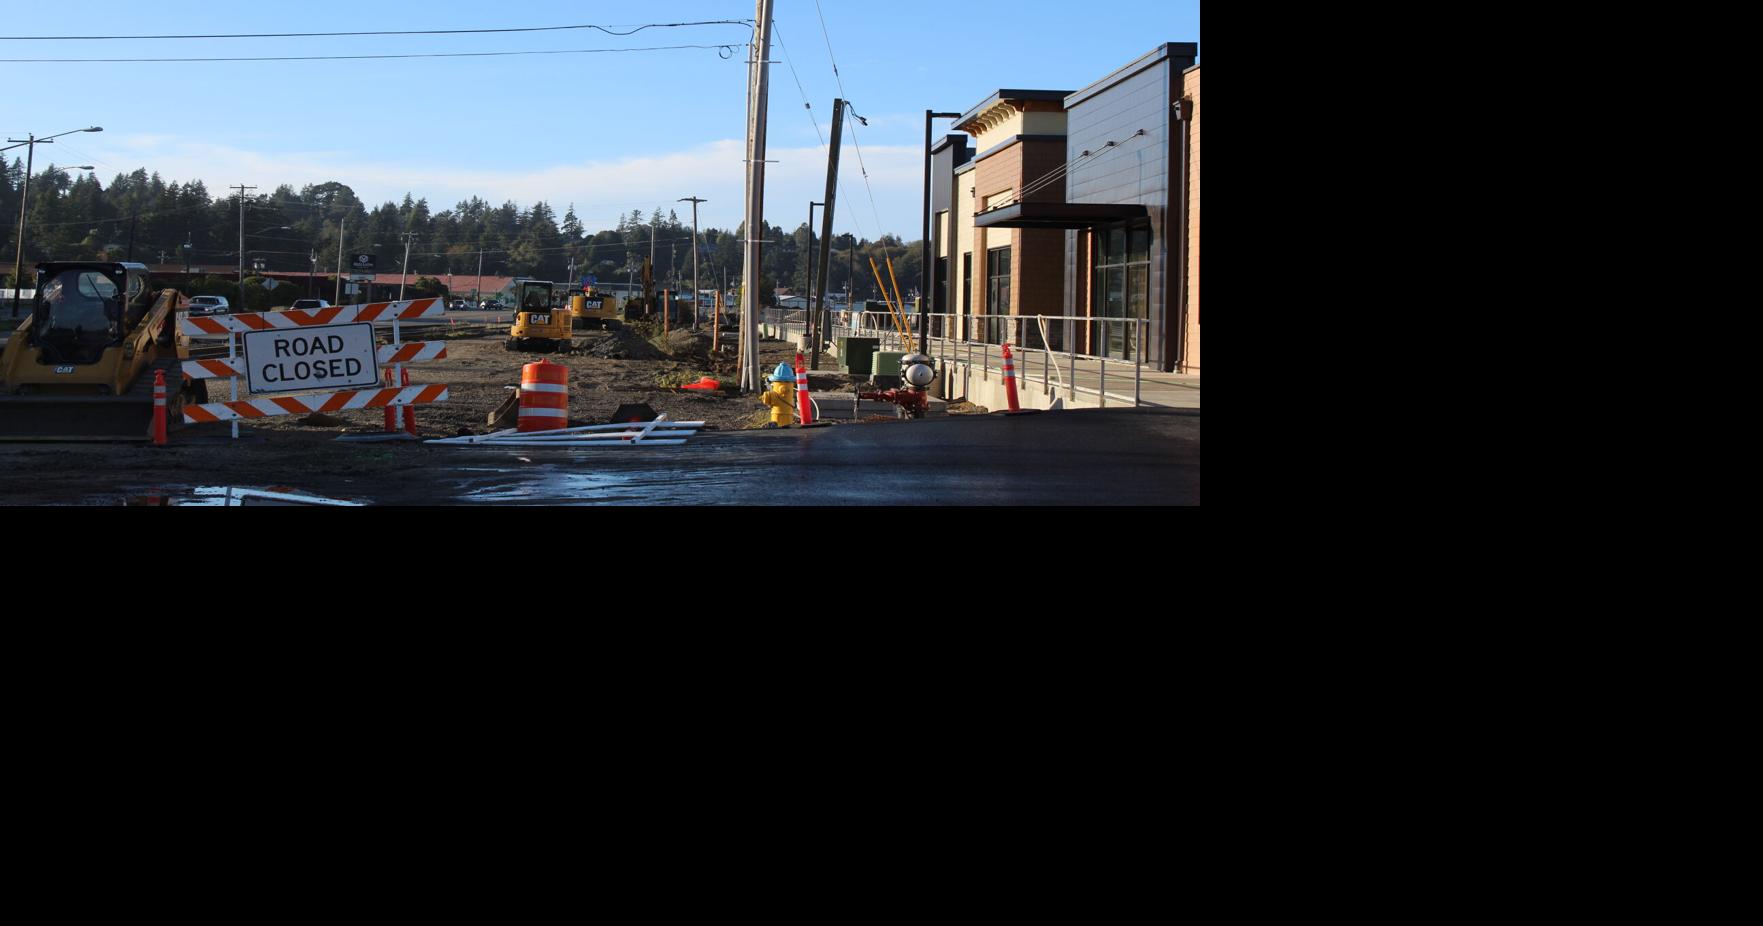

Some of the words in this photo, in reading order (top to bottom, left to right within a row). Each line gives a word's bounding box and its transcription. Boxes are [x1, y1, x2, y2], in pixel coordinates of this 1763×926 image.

[586, 301, 602, 309] CAT
[530, 314, 550, 324] CAT
[274, 335, 344, 358] ROAD
[56, 366, 74, 374] CAT
[262, 358, 362, 382] CLOSED
